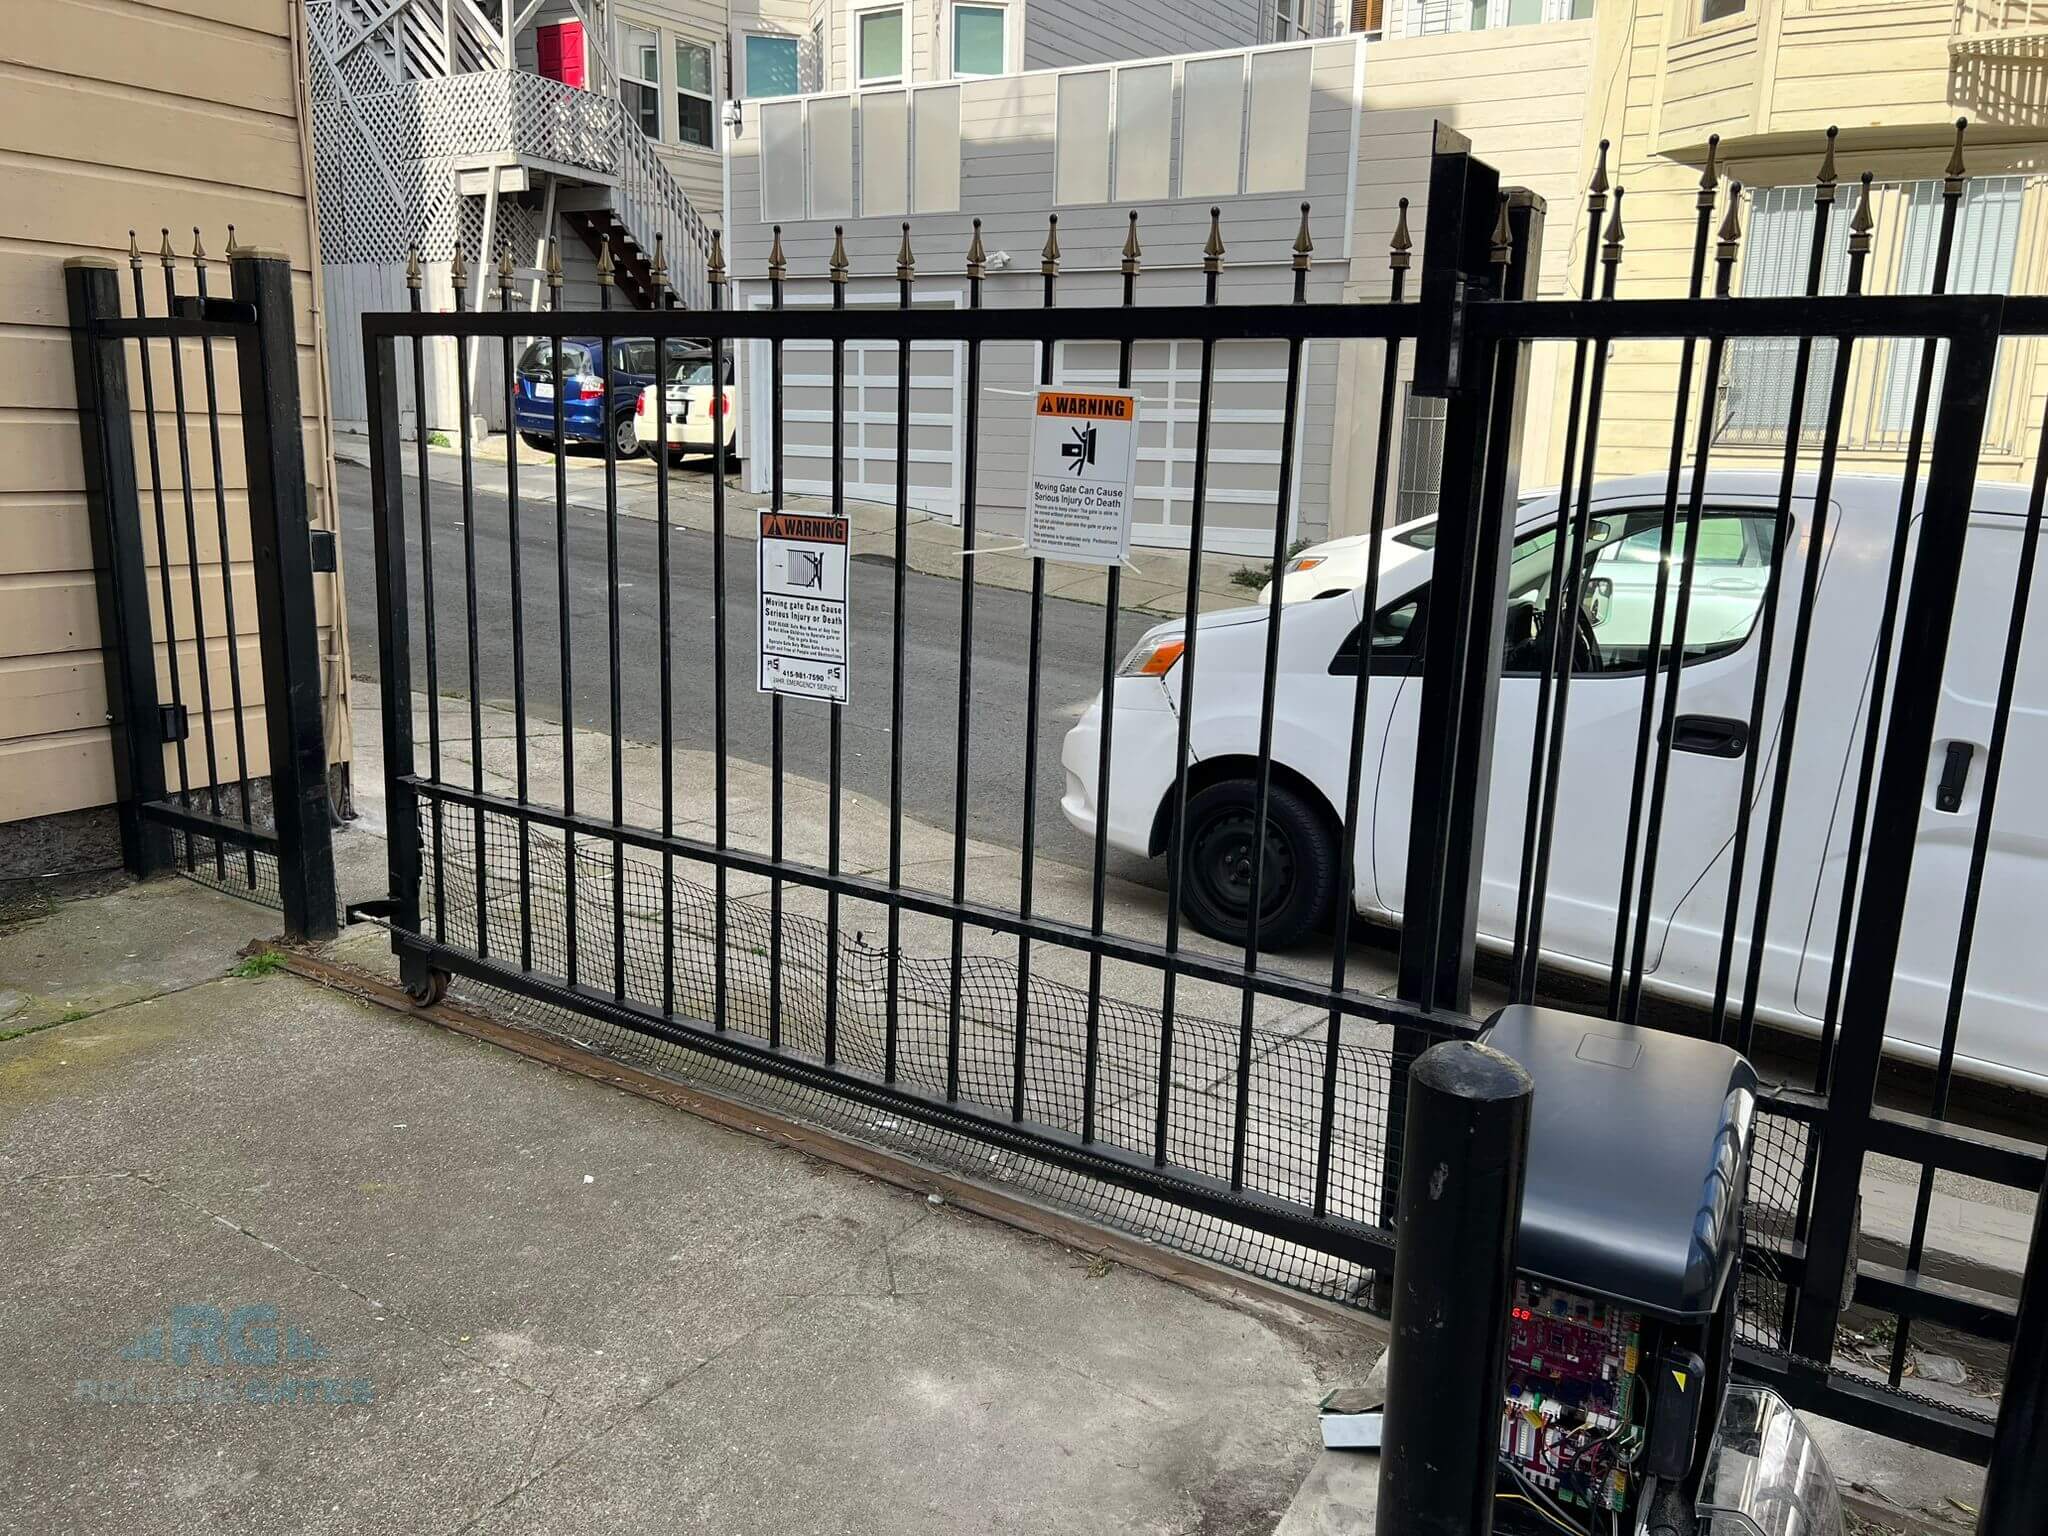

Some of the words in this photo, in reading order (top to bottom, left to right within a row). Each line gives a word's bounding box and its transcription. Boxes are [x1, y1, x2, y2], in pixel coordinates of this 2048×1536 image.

[1056, 397, 1125, 416] WARNING
[1034, 482, 1058, 493] Moving
[1060, 484, 1077, 493] Gate
[1079, 486, 1094, 495] Can
[1097, 487, 1123, 497] Cause
[1035, 492, 1059, 502] Serious
[1062, 495, 1082, 506] Injury
[1084, 497, 1094, 506] Or
[1096, 498, 1121, 508] Death
[784, 519, 843, 539] WARNING
[765, 597, 787, 610] Moving
[790, 602, 803, 610] gate
[806, 602, 819, 611] Can
[821, 604, 842, 614] Cause
[765, 608, 789, 619] Serious
[792, 611, 810, 623] Injury
[822, 614, 842, 624] Death
[786, 680, 816, 688] EMERGENCY
[817, 683, 837, 692] SERVICE
